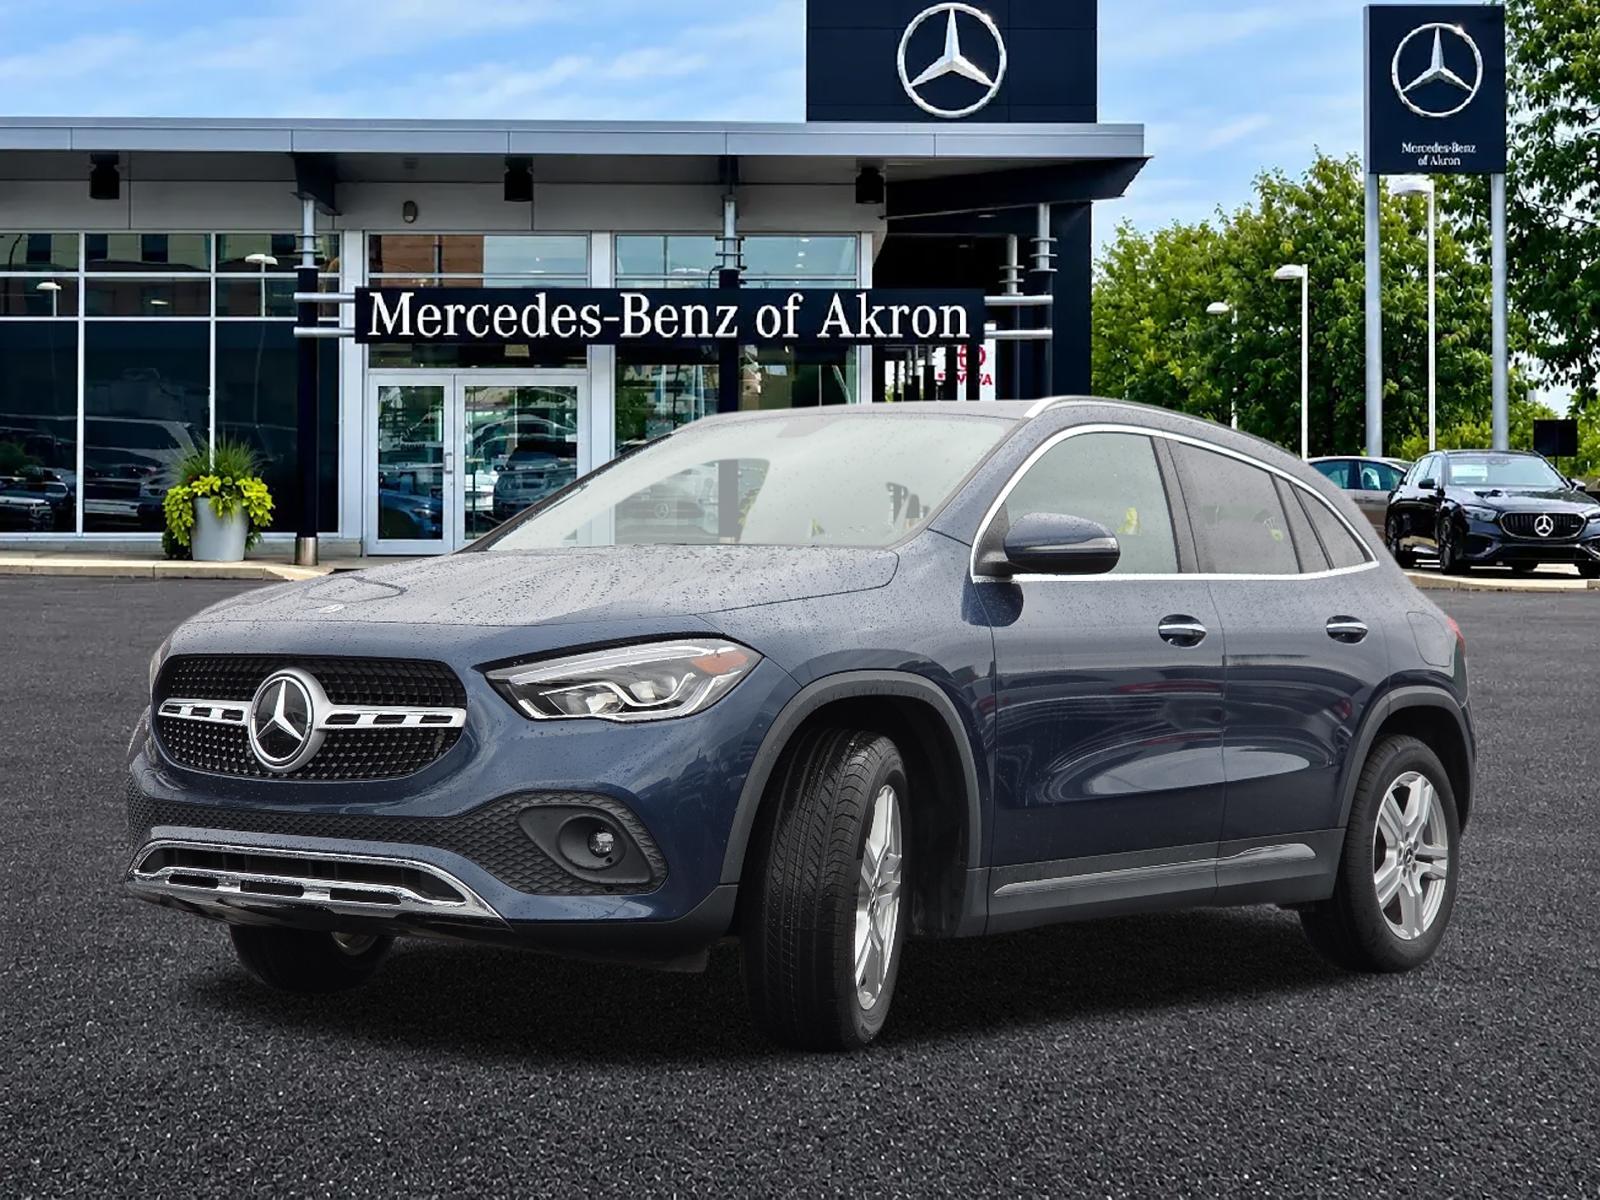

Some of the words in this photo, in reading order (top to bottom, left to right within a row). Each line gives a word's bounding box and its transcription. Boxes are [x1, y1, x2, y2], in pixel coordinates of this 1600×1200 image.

[1401, 141, 1477, 154] Mercedes-Benz
[1417, 154, 1429, 166] of
[1430, 154, 1461, 166] Akron
[367, 290, 738, 338] Mercedes-Benz
[755, 291, 805, 338] of
[816, 290, 971, 338] Akron
